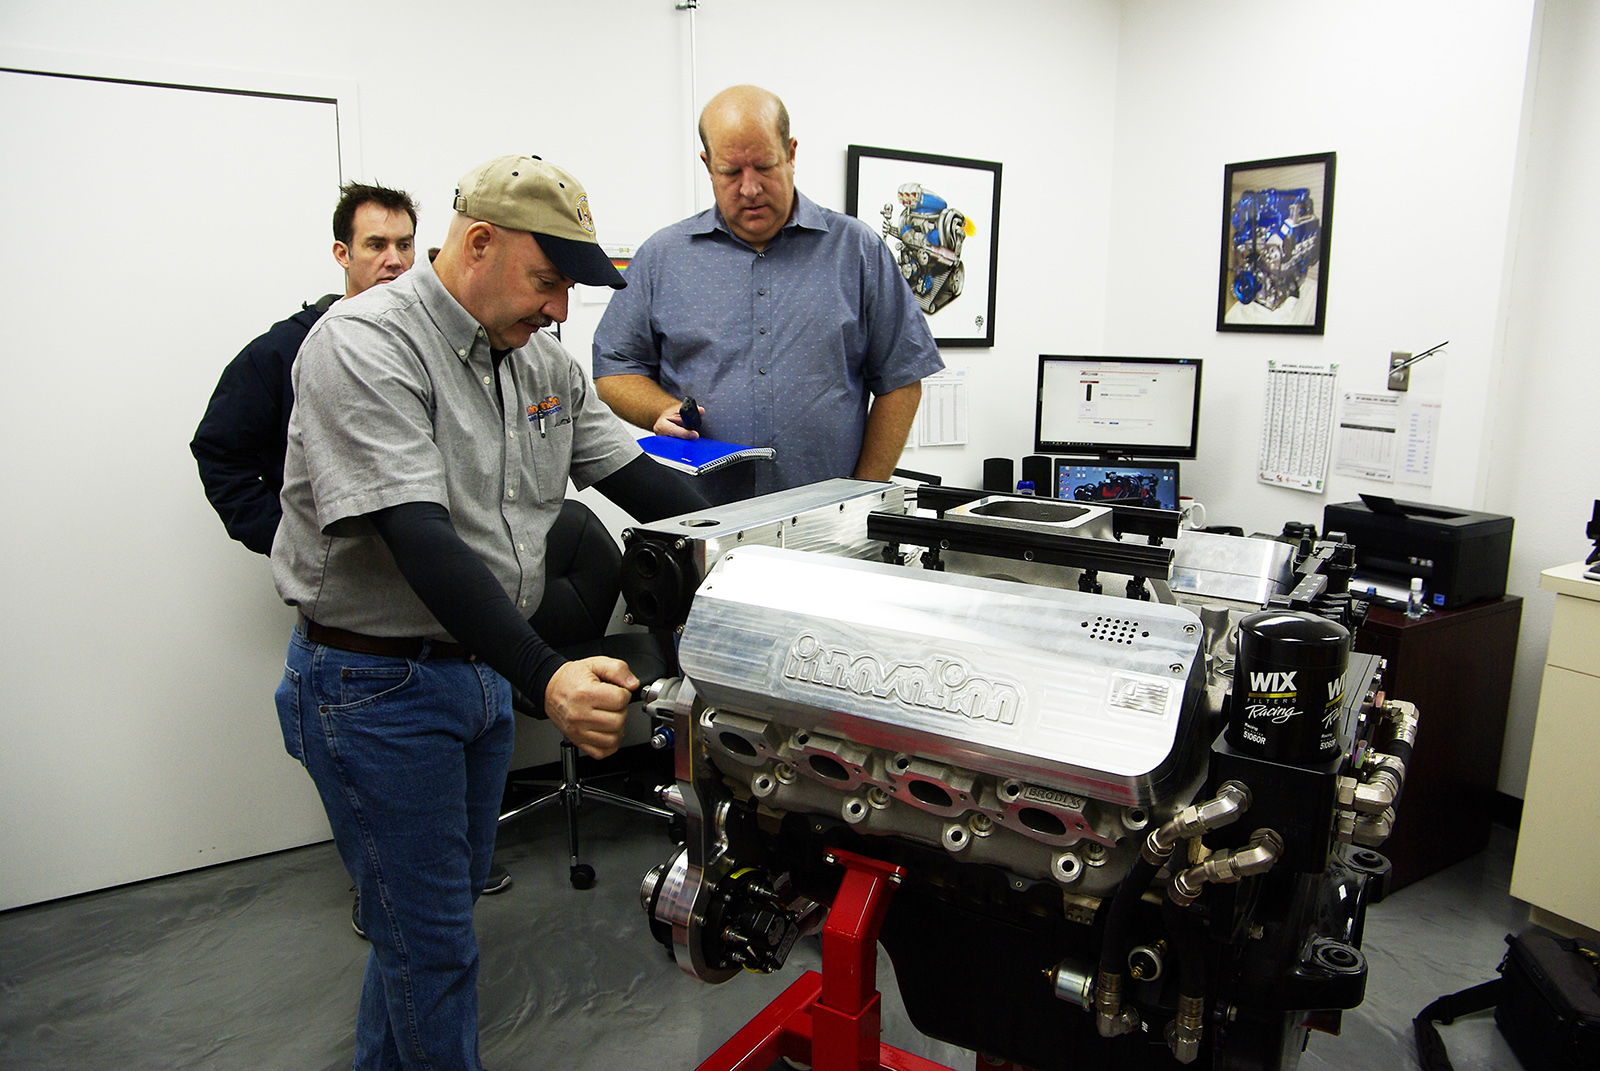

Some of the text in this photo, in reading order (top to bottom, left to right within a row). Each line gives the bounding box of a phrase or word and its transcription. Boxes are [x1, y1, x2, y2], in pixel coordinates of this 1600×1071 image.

[785, 633, 1021, 726] innovation
[1250, 671, 1297, 692] WIX
[1247, 697, 1297, 705] FILTERS
[1245, 705, 1303, 724] Racing
